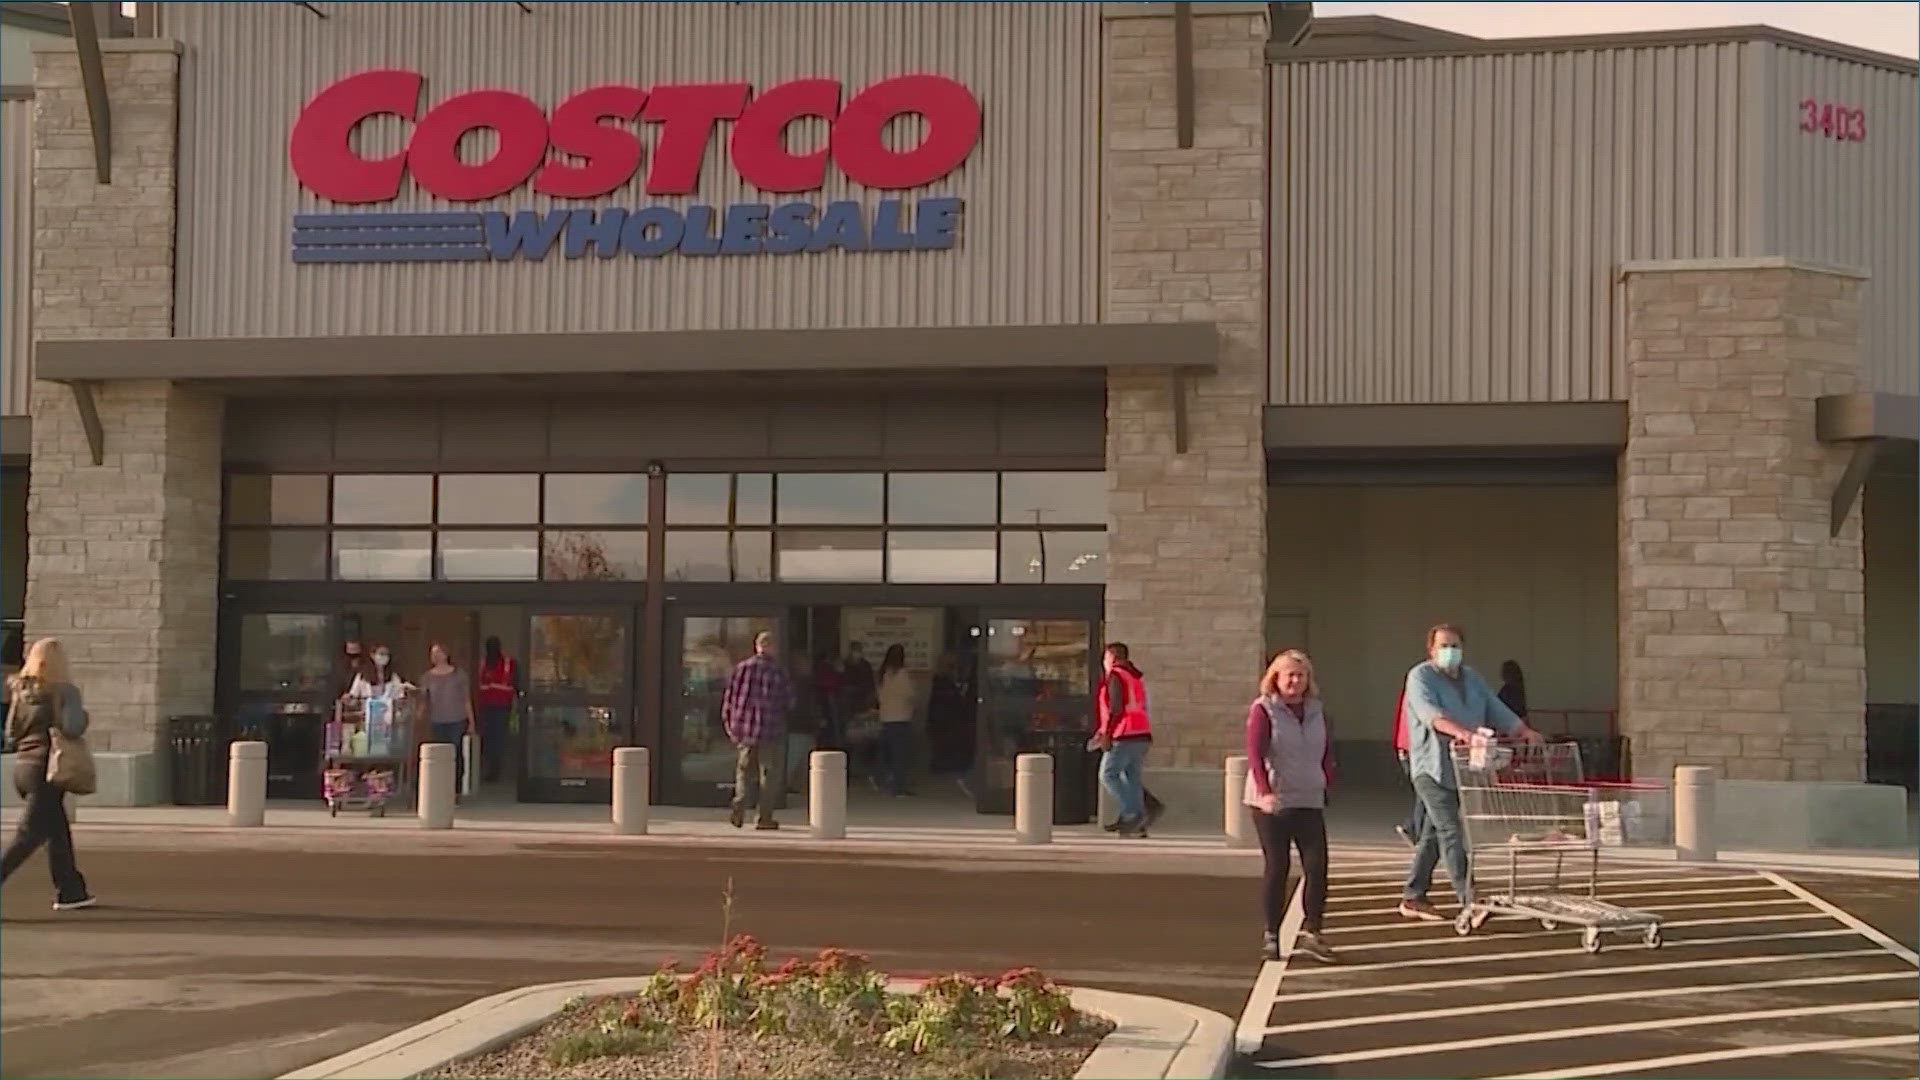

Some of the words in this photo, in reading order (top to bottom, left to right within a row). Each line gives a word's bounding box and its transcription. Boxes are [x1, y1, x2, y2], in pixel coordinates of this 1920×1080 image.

[290, 70, 983, 204] COSTCO
[1799, 98, 1867, 143] 3403
[485, 197, 964, 261] WHOLESALE
